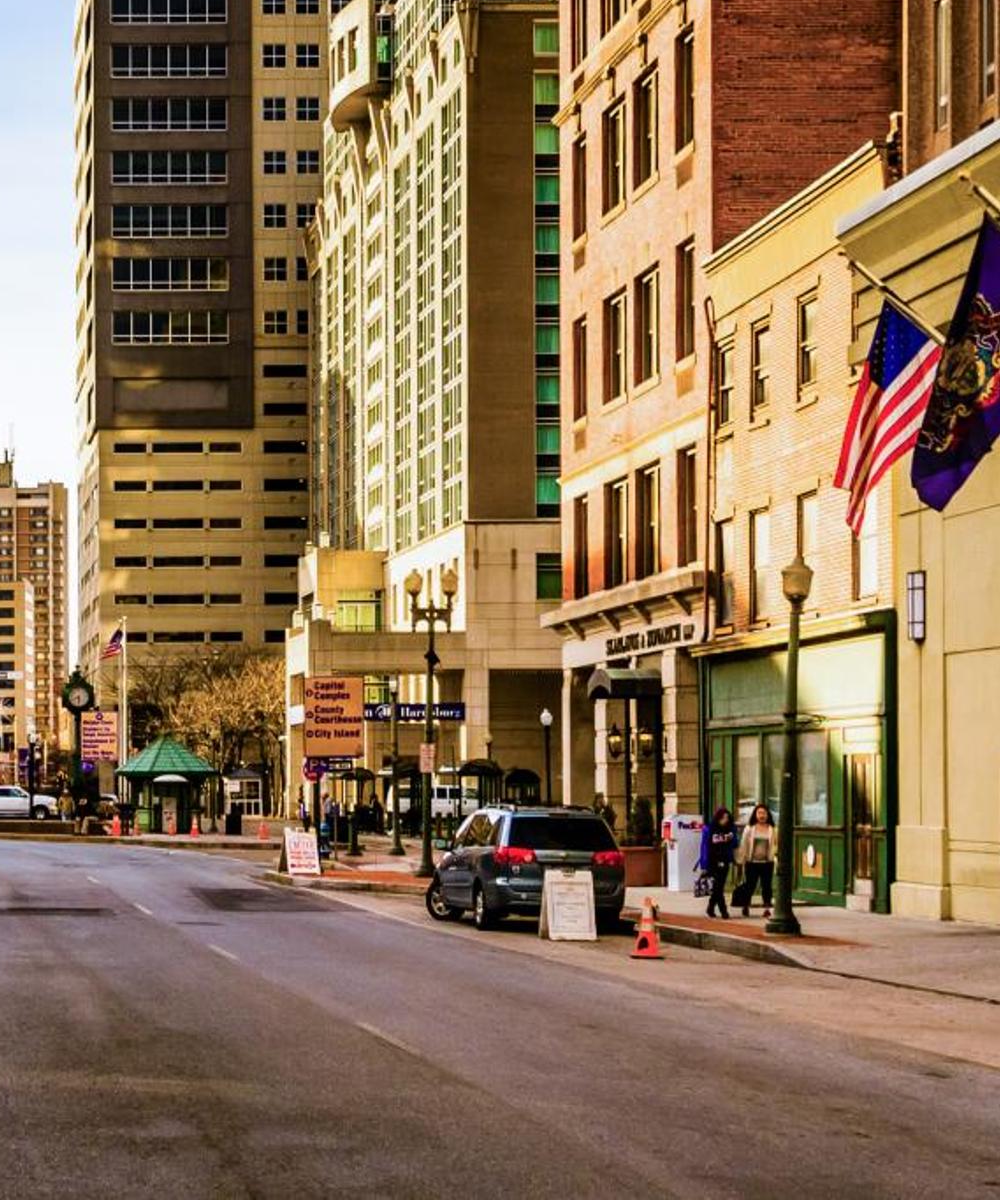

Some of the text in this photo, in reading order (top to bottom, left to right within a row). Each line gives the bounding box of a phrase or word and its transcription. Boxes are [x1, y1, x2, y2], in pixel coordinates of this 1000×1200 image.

[314, 691, 350, 701] Complex
[314, 705, 344, 715] County
[401, 706, 461, 718] Harrburg
[314, 715, 362, 724] Courthouse
[314, 729, 361, 739] City Island
